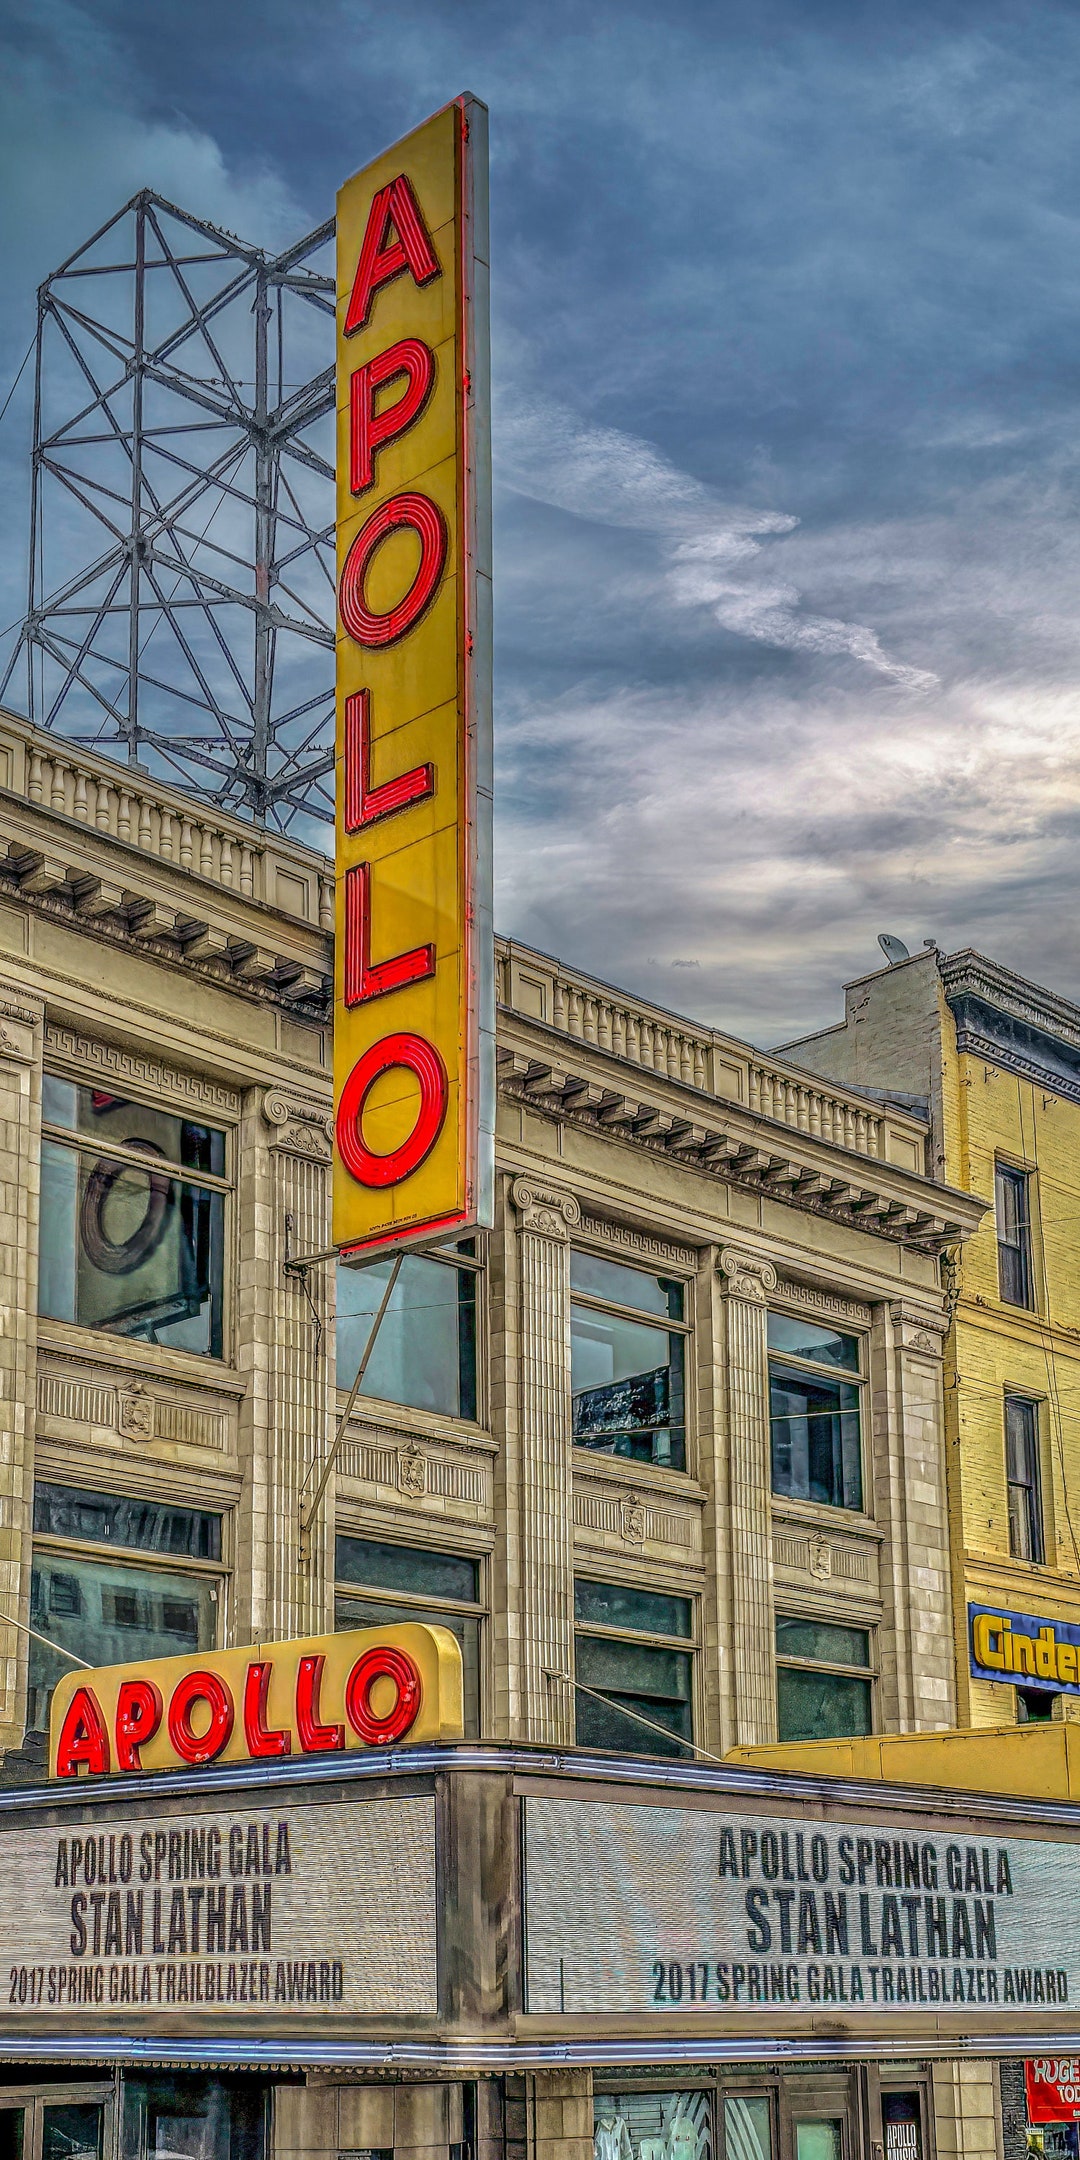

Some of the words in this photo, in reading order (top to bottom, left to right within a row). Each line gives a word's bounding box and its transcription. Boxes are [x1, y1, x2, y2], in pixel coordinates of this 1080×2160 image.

[336, 173, 449, 1190] APOLLO
[973, 1614, 1080, 1683] Cinde
[56, 1645, 423, 1778] APOLLO
[55, 1832, 133, 1888] APOLLO
[139, 1825, 221, 1883] SPRING
[229, 1822, 292, 1876] GALA
[718, 1826, 830, 1884] APOLLO
[838, 1835, 938, 1890] SPRING
[946, 1843, 1014, 1895] GALA
[70, 1888, 144, 1957] STAN
[152, 1882, 272, 1953] LATHAN
[745, 1887, 850, 1955] STAN
[859, 1892, 998, 1960] LATHAN
[9, 1965, 45, 2004] 2017
[48, 1964, 104, 2004] SPRING
[108, 1963, 151, 2003] GALA
[155, 1961, 270, 2003] TRAILBLAZER
[274, 1961, 344, 2001] AWARD
[653, 1961, 709, 2002] 2017
[716, 1963, 799, 2002] SPRING
[807, 1965, 866, 2003] GALA
[869, 1966, 1000, 2003] TRAILBLAZER
[1003, 1969, 1069, 2003] AWARD
[886, 2124, 917, 2148] APOLLO
